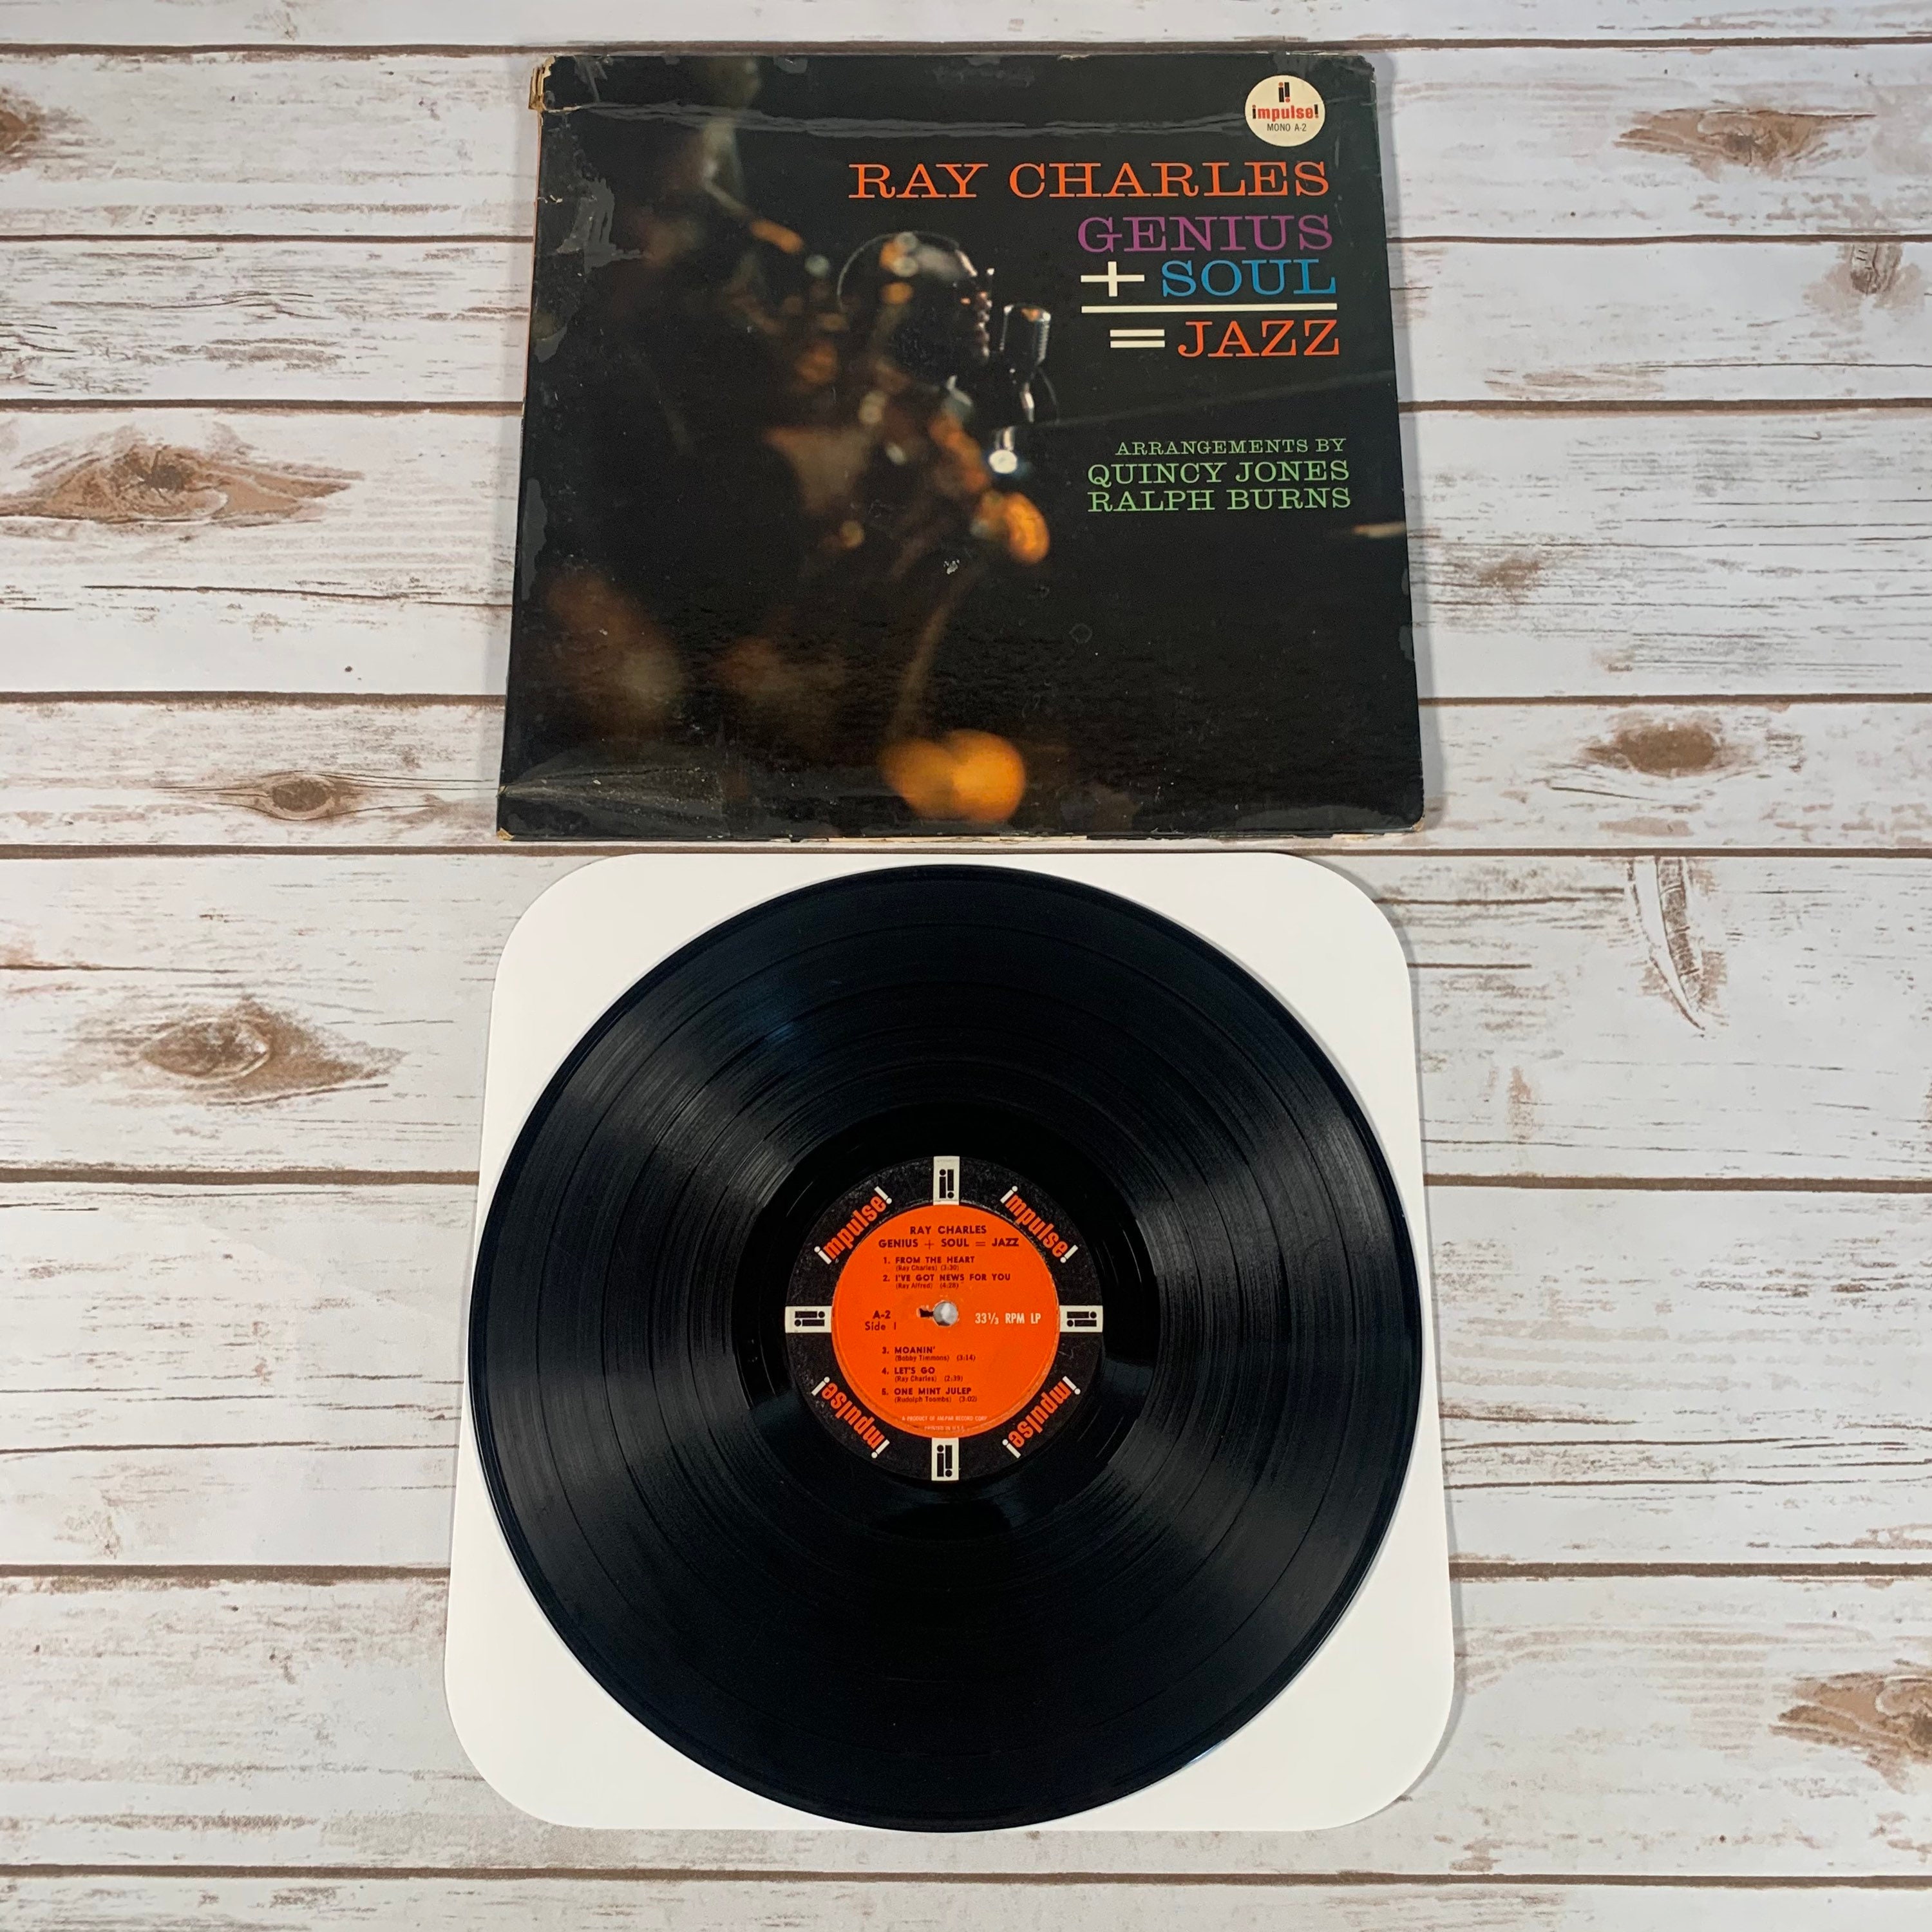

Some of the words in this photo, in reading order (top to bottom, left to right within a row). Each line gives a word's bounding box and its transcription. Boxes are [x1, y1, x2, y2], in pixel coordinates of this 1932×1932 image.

[1251, 104, 1320, 122] impulse!
[1267, 123, 1291, 132] MONO
[1294, 123, 1307, 132] A-2
[848, 162, 989, 200] RAY
[1009, 160, 1330, 198] CHARLES
[1078, 214, 1333, 253] GENIUS
[1162, 259, 1337, 298] SOUL
[1177, 319, 1340, 358] JAZZ
[1115, 439, 1309, 455] ARRANGEMENTS
[1314, 438, 1347, 454] BY
[1086, 461, 1226, 488] QUINCY
[1235, 459, 1350, 483] JONES
[1086, 489, 1215, 513] RALPH
[1226, 487, 1352, 511] BURNS
[813, 1186, 893, 1265] impulse!
[909, 1225, 932, 1236] RAY
[937, 1224, 987, 1235] CHARLES
[999, 1185, 1079, 1264] impulse!
[878, 1238, 919, 1249] GENIUS
[941, 1238, 970, 1248] SOUL
[991, 1237, 1019, 1247] JAZZ
[883, 1256, 891, 1264] 1.
[895, 1256, 920, 1264] FROM
[947, 1255, 976, 1264] HEART
[882, 1274, 890, 1283] 2.
[939, 1273, 965, 1282] NEWS
[992, 1273, 1011, 1281] YOU
[872, 1310, 891, 1320] A-2
[1005, 1312, 1025, 1325] RPM
[1030, 1312, 1042, 1324] LP
[864, 1321, 886, 1331] Side
[894, 1346, 936, 1354] MOANIN'
[894, 1367, 916, 1375] LET'S
[920, 1367, 936, 1375] GO
[918, 1387, 941, 1396] MINT
[945, 1387, 972, 1395] JULEP
[811, 1376, 891, 1459] impulse!
[1002, 1376, 1081, 1459] impulse!
